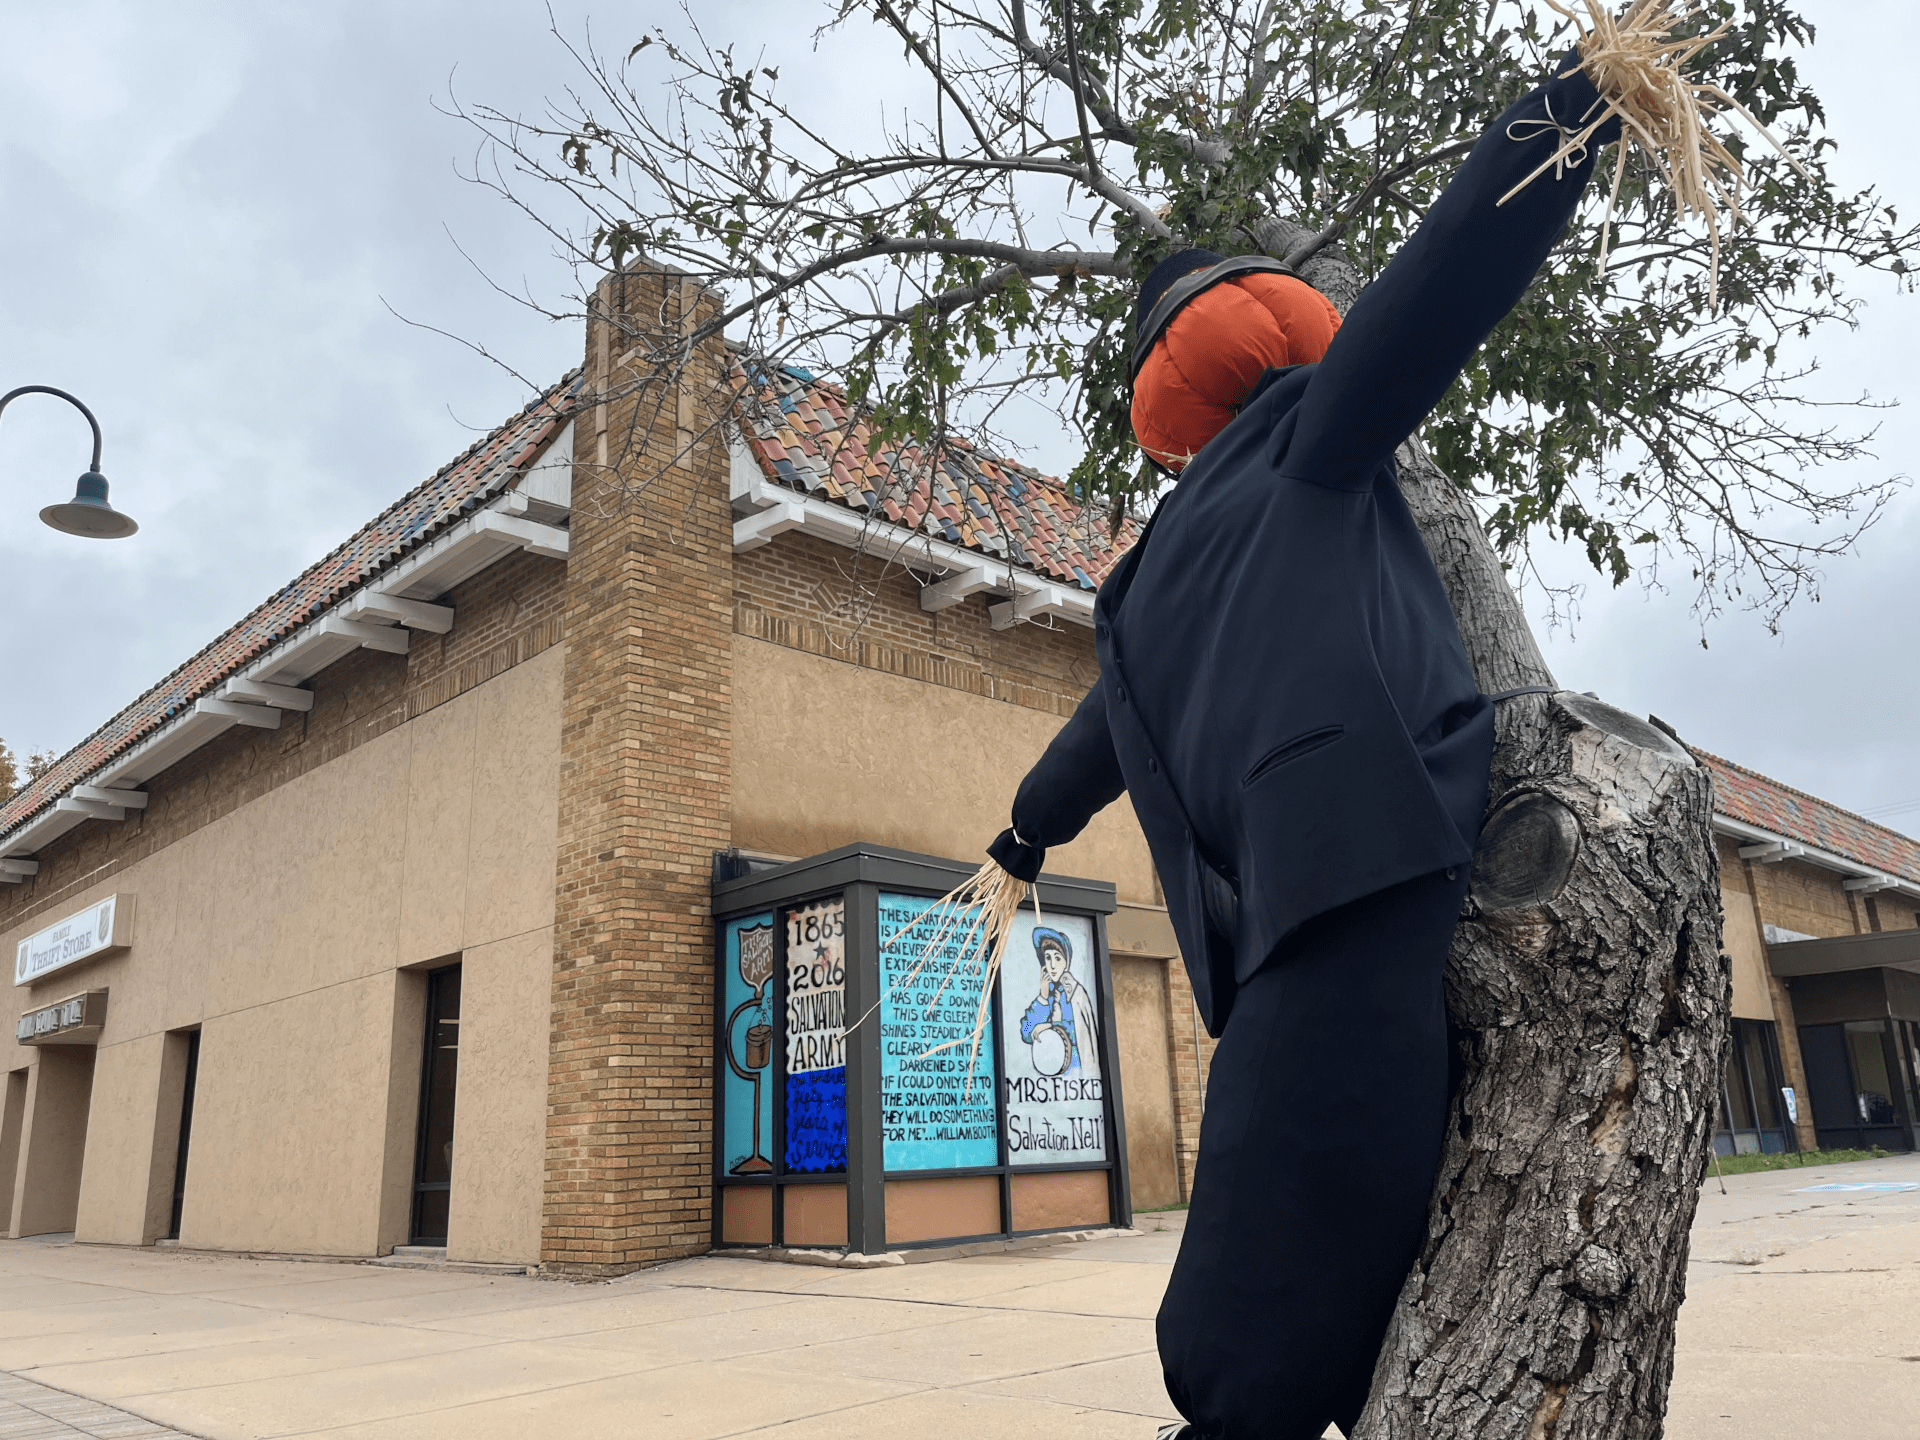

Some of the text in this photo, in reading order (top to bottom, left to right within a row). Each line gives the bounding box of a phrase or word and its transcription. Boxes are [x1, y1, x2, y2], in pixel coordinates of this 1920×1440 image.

[879, 907, 903, 923] THE
[795, 911, 845, 946] 1865
[881, 925, 891, 938] IS
[895, 924, 902, 939] A
[32, 930, 92, 972] THRIFT STORE
[794, 957, 845, 992] 2016
[888, 973, 921, 989] EVERY
[923, 976, 955, 990] OTHER
[890, 992, 912, 1005] HAS
[791, 990, 846, 1035] SALVATION
[893, 1007, 977, 1024] THIS ONE GLEEM
[881, 1023, 916, 1038] SHINES
[920, 1025, 961, 1040] STEADILY
[792, 1032, 846, 1072] ARMY
[887, 1041, 931, 1056] CLEARLY
[955, 1043, 965, 1056] IN
[965, 1043, 983, 1057] TE
[900, 1059, 955, 1073] DARKENED
[902, 1075, 934, 1089] COULD
[936, 1076, 962, 1090] ONLY
[962, 1076, 979, 1090] GET
[979, 1076, 992, 1090] TO
[1006, 1077, 1103, 1104] MRS. FISKE
[882, 1092, 903, 1107] THE
[905, 1092, 957, 1107] SALVATION
[882, 1108, 995, 1125] HEY WILL DO SOMETHING
[882, 1127, 905, 1141] FOR
[936, 1125, 973, 1140] WILLIAM
[973, 1124, 996, 1139] BOOTH
